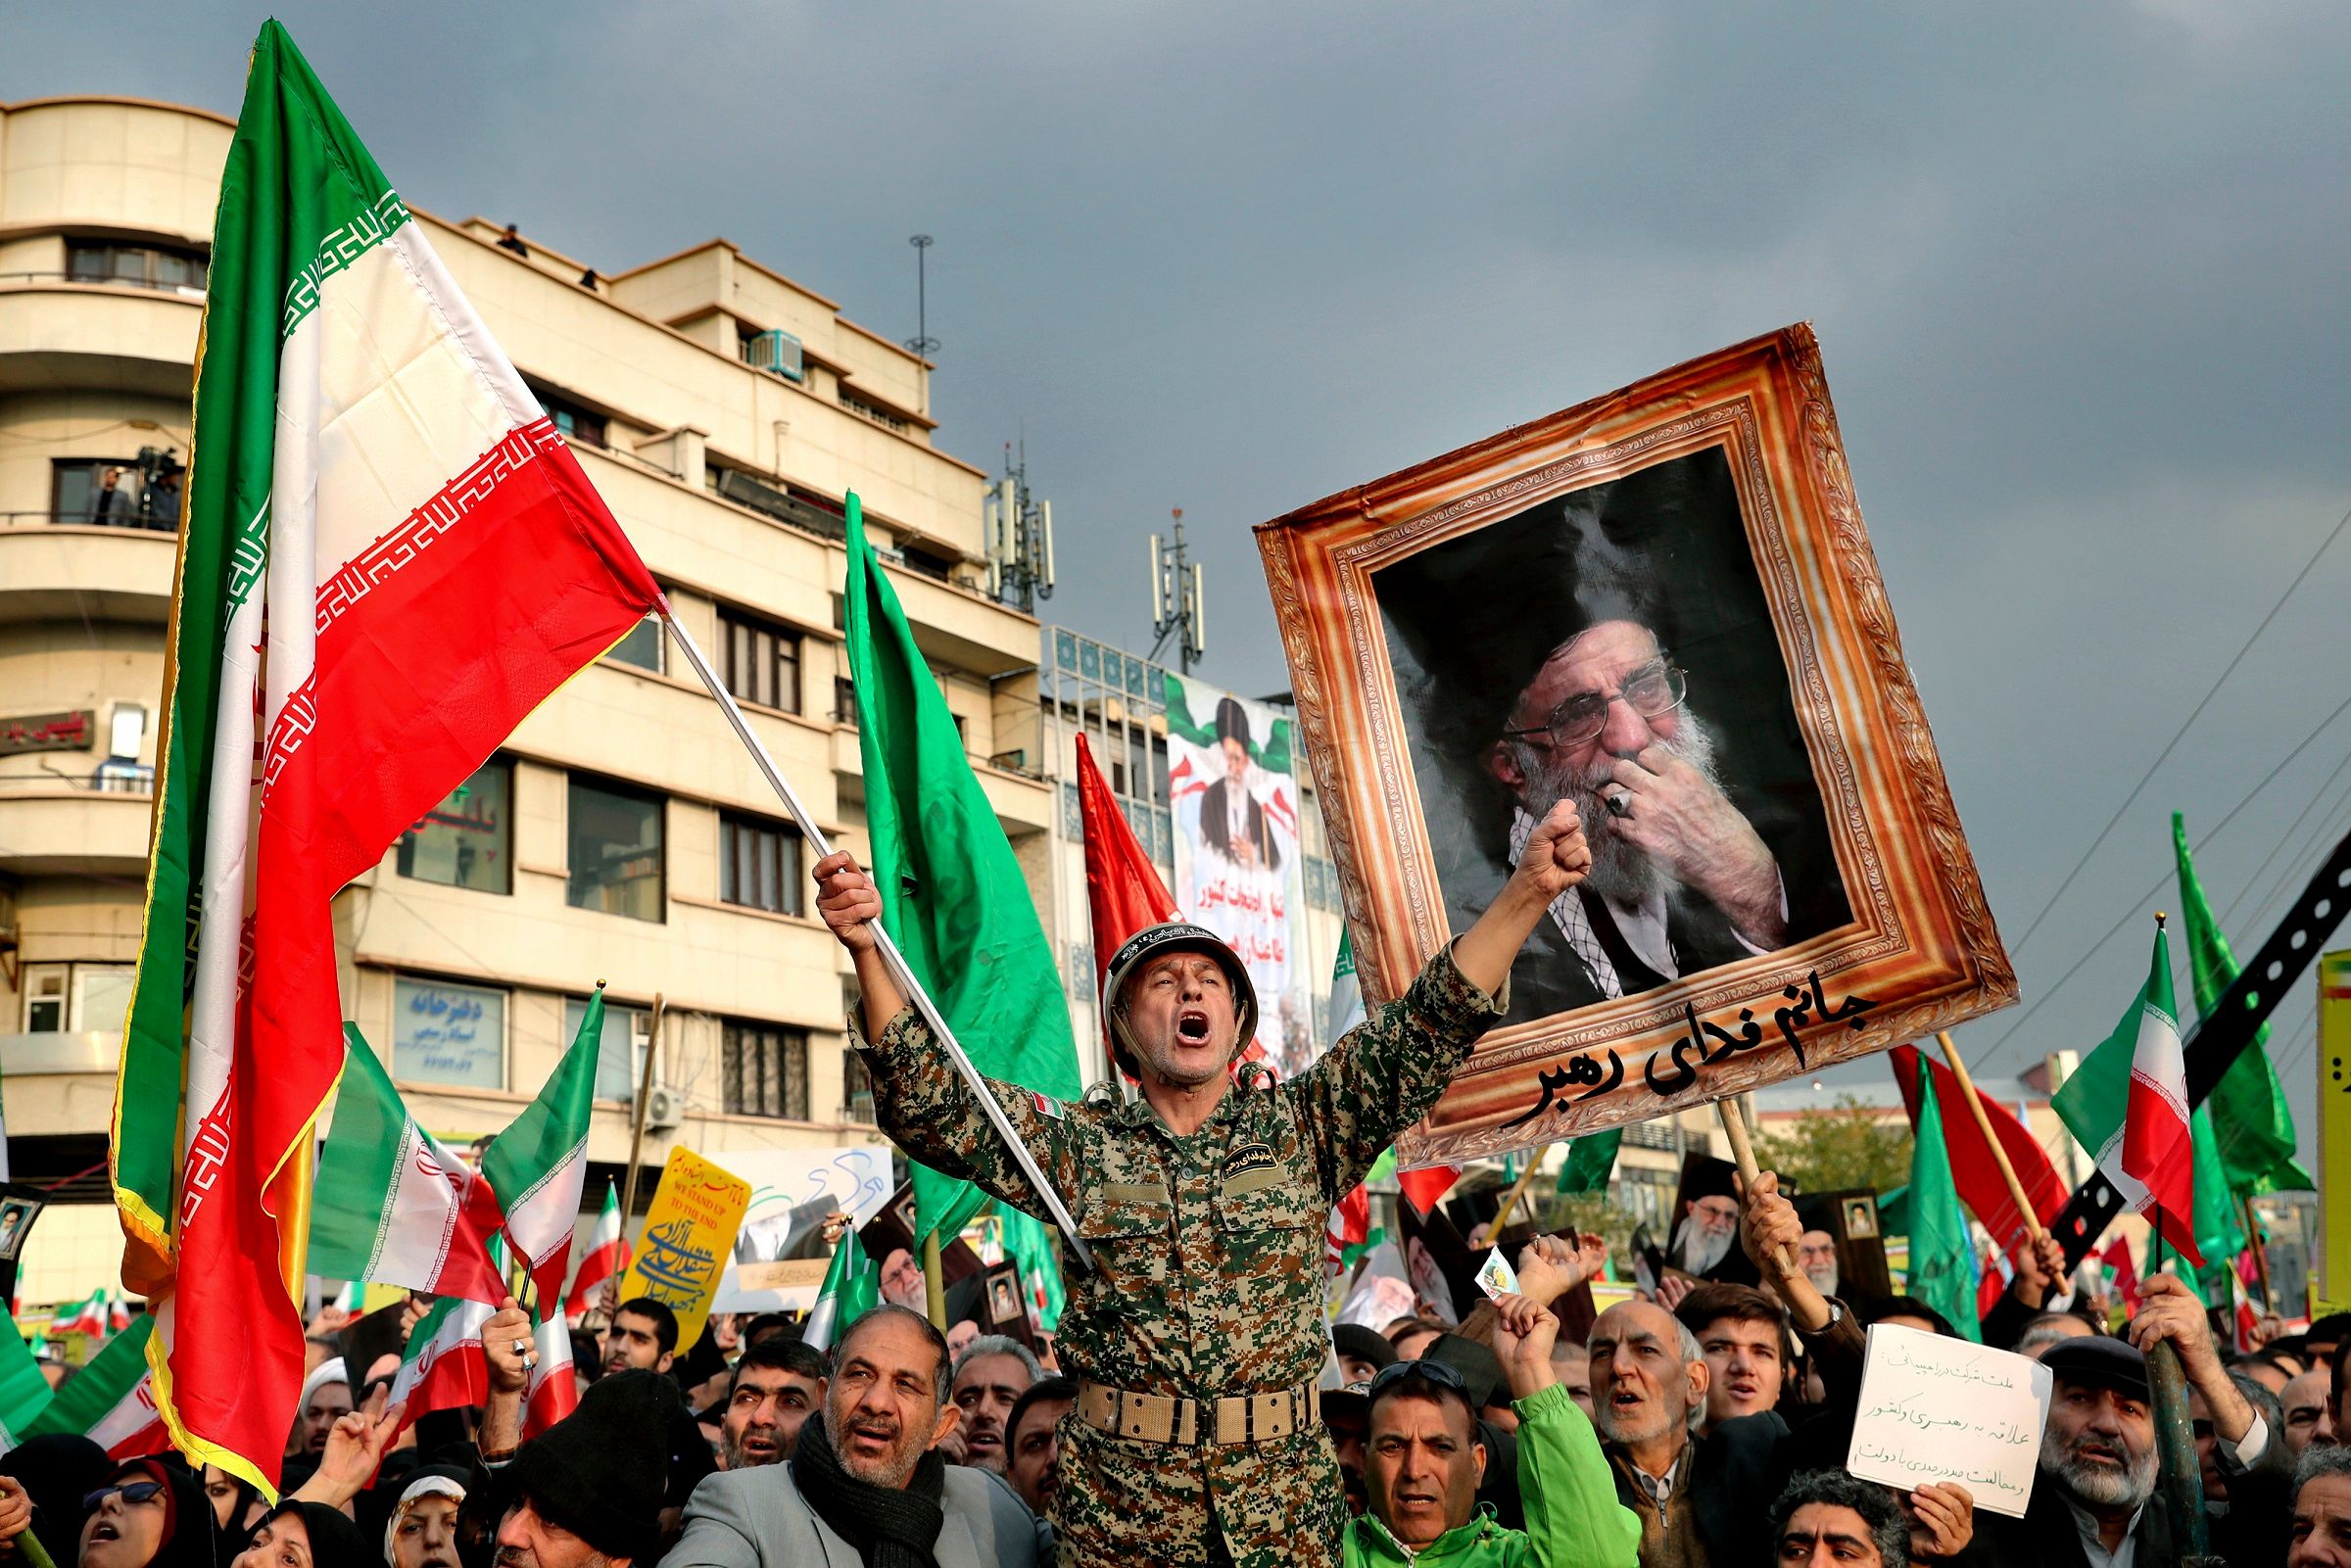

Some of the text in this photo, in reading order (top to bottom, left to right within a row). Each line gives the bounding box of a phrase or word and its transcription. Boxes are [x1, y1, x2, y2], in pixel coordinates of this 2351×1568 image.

[1499, 970, 1881, 1130] جانم فدای رهبر
[673, 1181, 727, 1217] WE STAND UP
[670, 1196, 719, 1231] TO THE END
[1950, 1354, 1983, 1384] شرکت
[1982, 1373, 2014, 1390] علت
[1862, 1391, 1925, 1418] کشور
[1909, 1408, 1969, 1433] رهبری
[1973, 1425, 1985, 1438] به
[1991, 1420, 2031, 1446] علاقه
[1966, 1469, 2016, 1491] مخالفت
